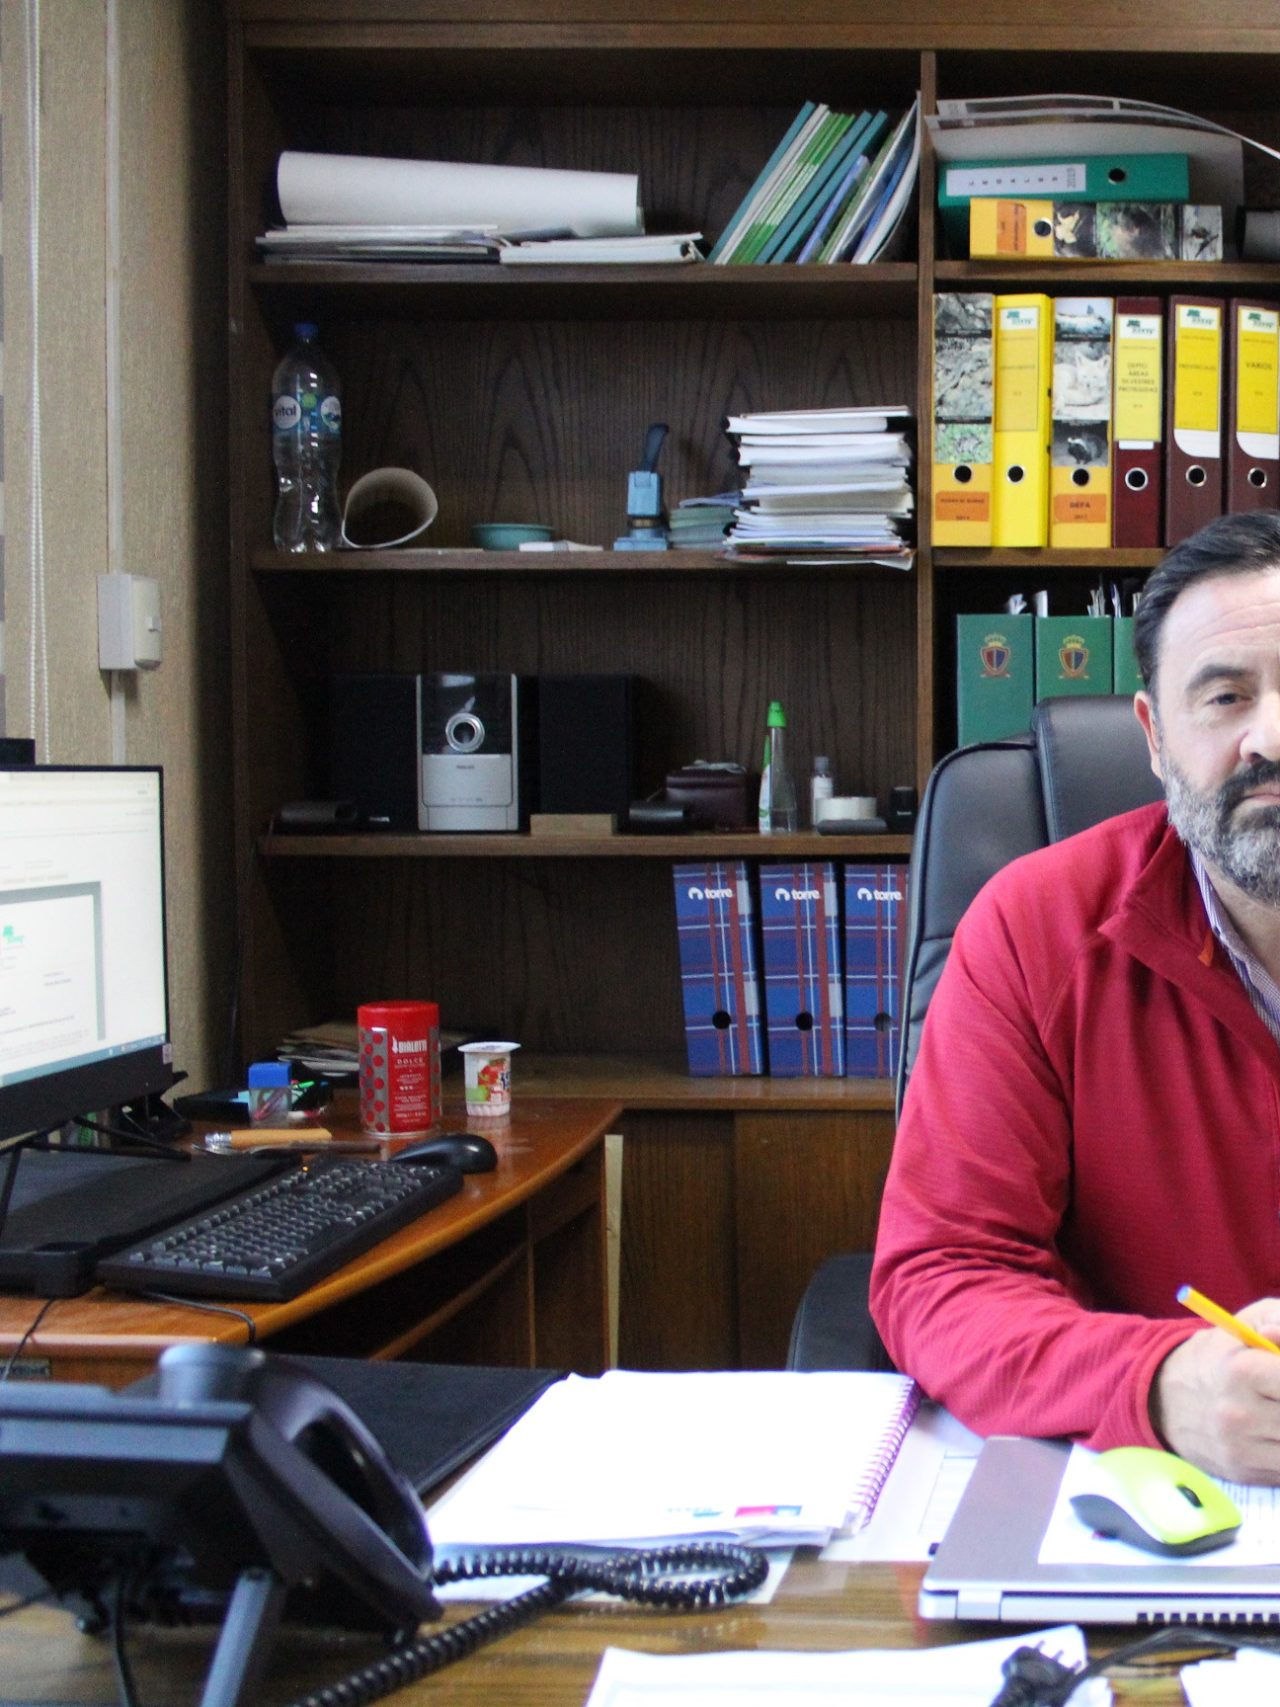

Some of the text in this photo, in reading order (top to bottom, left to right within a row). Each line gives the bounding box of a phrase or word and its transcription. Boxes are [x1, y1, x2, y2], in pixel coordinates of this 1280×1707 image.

[704, 888, 733, 899] torre
[791, 888, 821, 901] torre
[873, 888, 903, 901] torre
